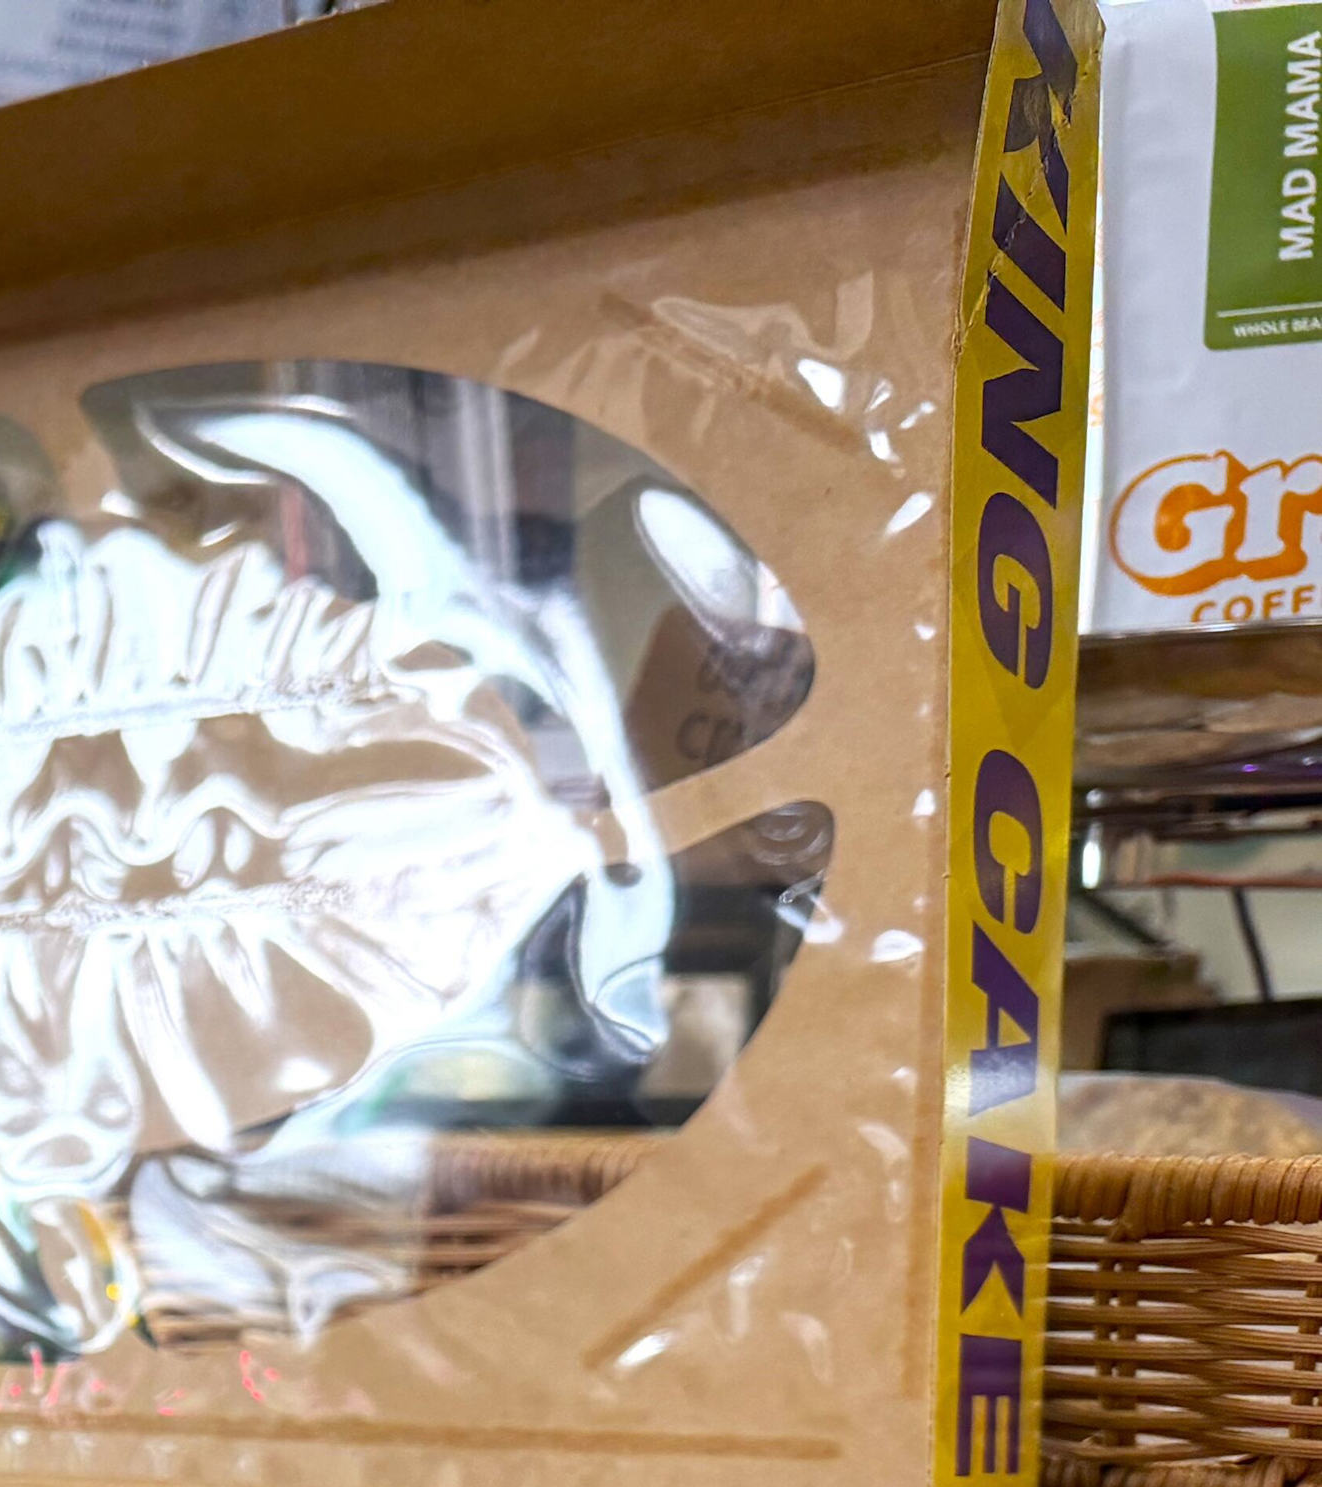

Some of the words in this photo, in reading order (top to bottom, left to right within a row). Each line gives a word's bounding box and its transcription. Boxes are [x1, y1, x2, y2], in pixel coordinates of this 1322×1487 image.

[1283, 31, 1322, 157] MAMA
[1278, 167, 1317, 261] MAD
[977, 0, 1079, 689] KING
[1233, 319, 1289, 337] WHOLE
[1291, 316, 1322, 333] BEA
[1107, 449, 1322, 598] Gr
[1190, 584, 1322, 622] COFF
[955, 749, 1044, 1477] CAKE
